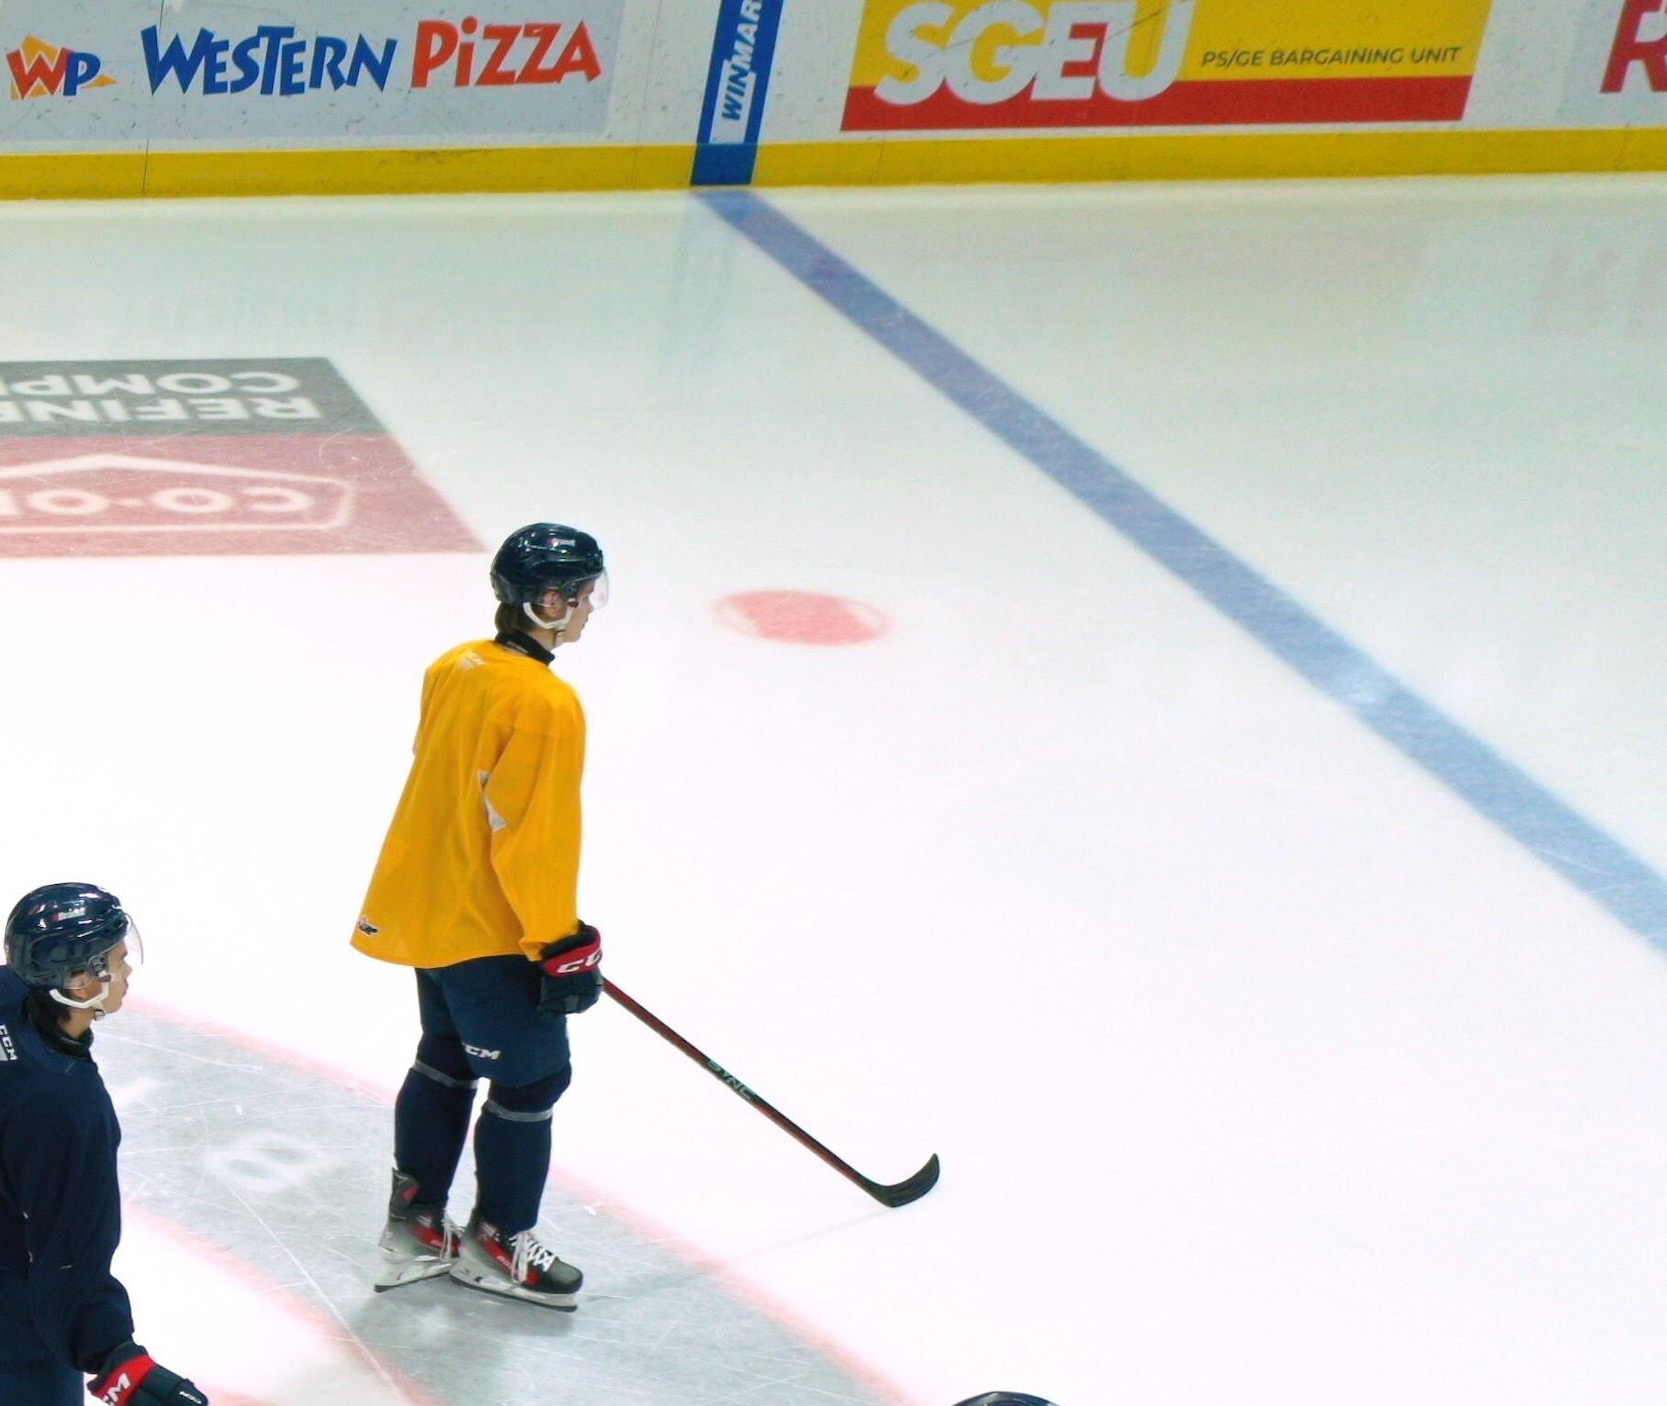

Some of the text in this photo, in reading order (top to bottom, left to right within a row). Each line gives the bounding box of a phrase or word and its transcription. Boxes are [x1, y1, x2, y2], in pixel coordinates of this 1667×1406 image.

[140, 26, 398, 97] WESTERN
[873, 0, 1198, 106] SGEU
[1200, 46, 1463, 69] PS/GE BARGAINING UNIT
